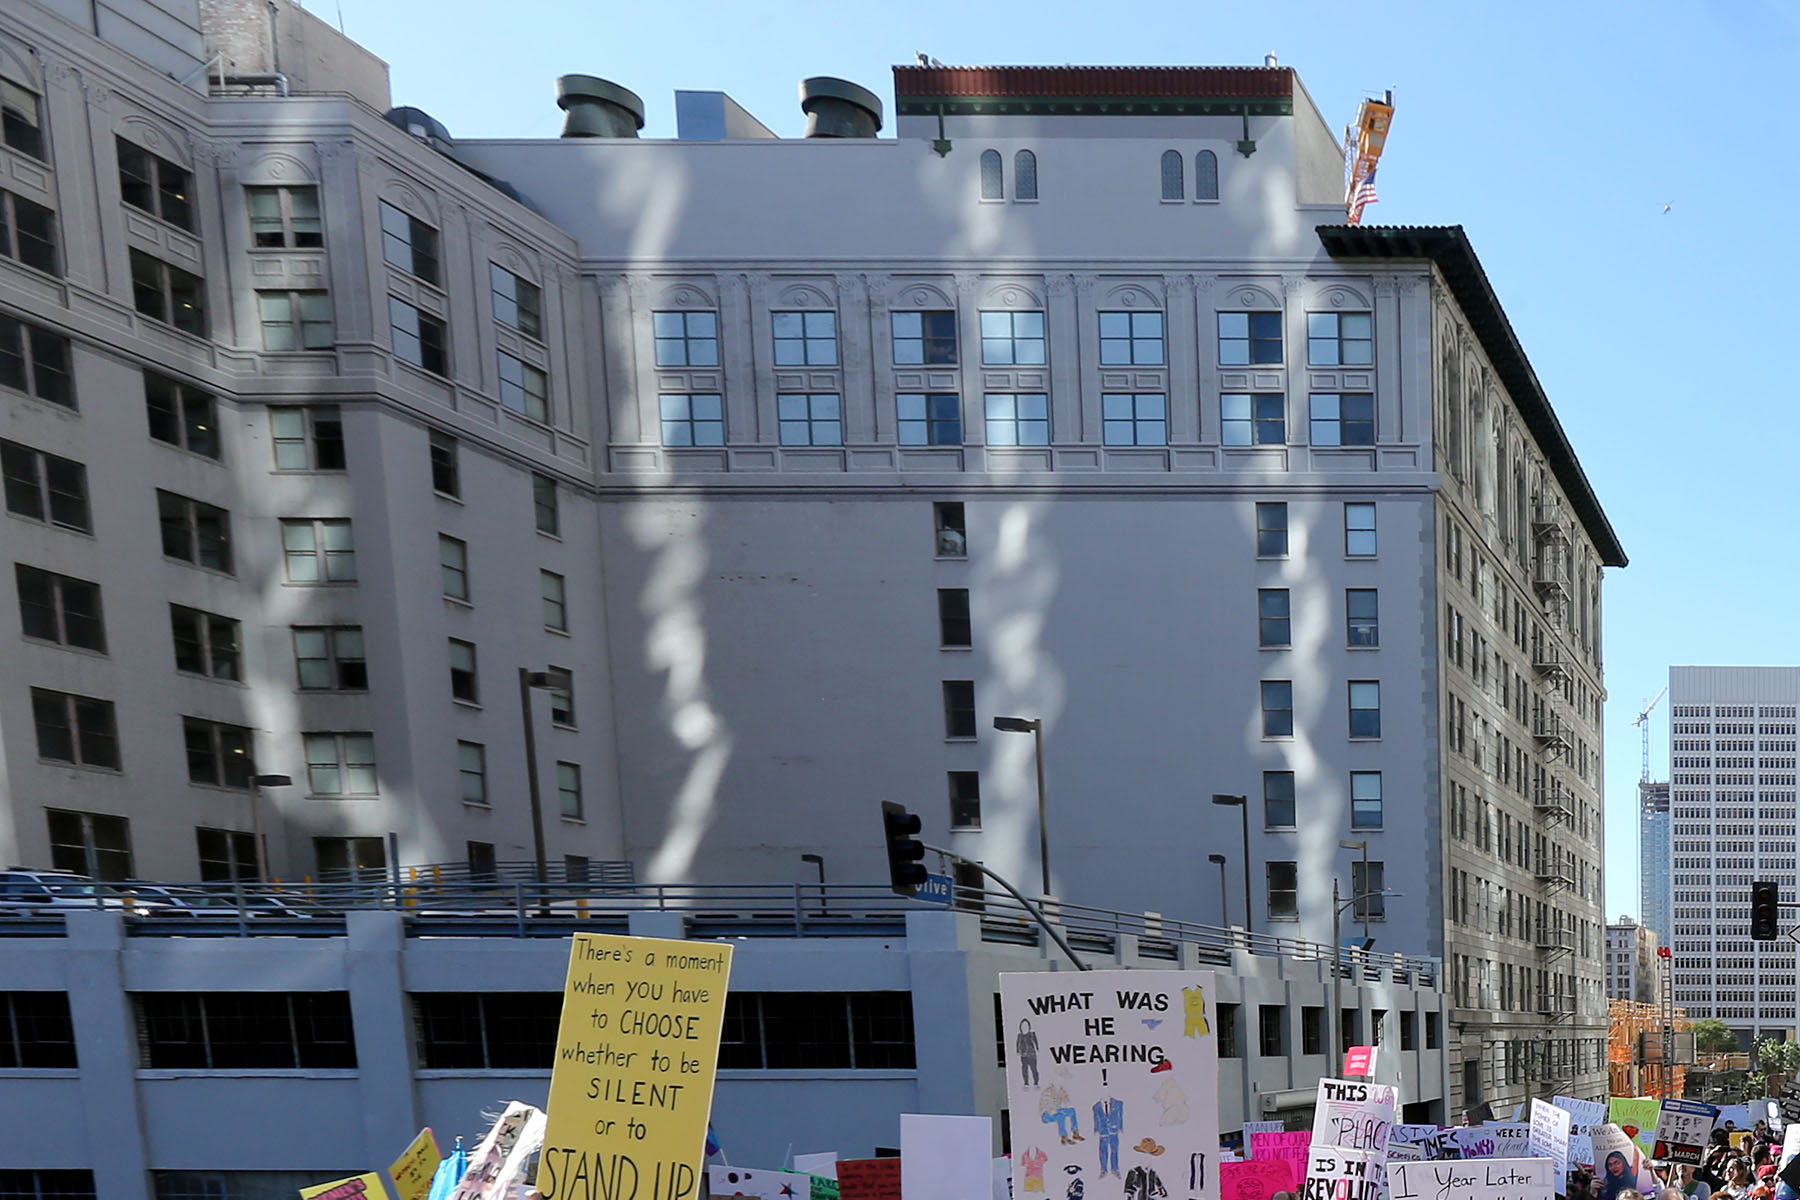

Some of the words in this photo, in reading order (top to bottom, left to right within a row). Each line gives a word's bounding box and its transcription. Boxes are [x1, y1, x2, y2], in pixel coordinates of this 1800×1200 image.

[575, 938, 632, 963] There's
[645, 953, 655, 967] a
[666, 952, 724, 974] moment
[572, 973, 615, 996] when
[672, 980, 710, 1003] have
[1028, 992, 1094, 1016] WHAT
[1116, 990, 1169, 1012] WAS
[591, 1008, 608, 1029] to
[620, 1010, 700, 1040] CHOOSE
[1084, 1017, 1115, 1036] HE
[562, 1041, 639, 1069] whether
[651, 1050, 670, 1073] to
[681, 1051, 700, 1074] be
[1050, 1043, 1165, 1065] WEARING
[587, 1077, 684, 1111] SILENT
[1324, 1083, 1368, 1102] THIS
[595, 1118, 616, 1136] or
[627, 1117, 647, 1140] to
[1316, 1159, 1336, 1172] IS
[1344, 1161, 1366, 1176] IN
[1674, 1150, 1700, 1160] MARCH
[1394, 1165, 1419, 1199] 1
[1486, 1166, 1532, 1187] Later
